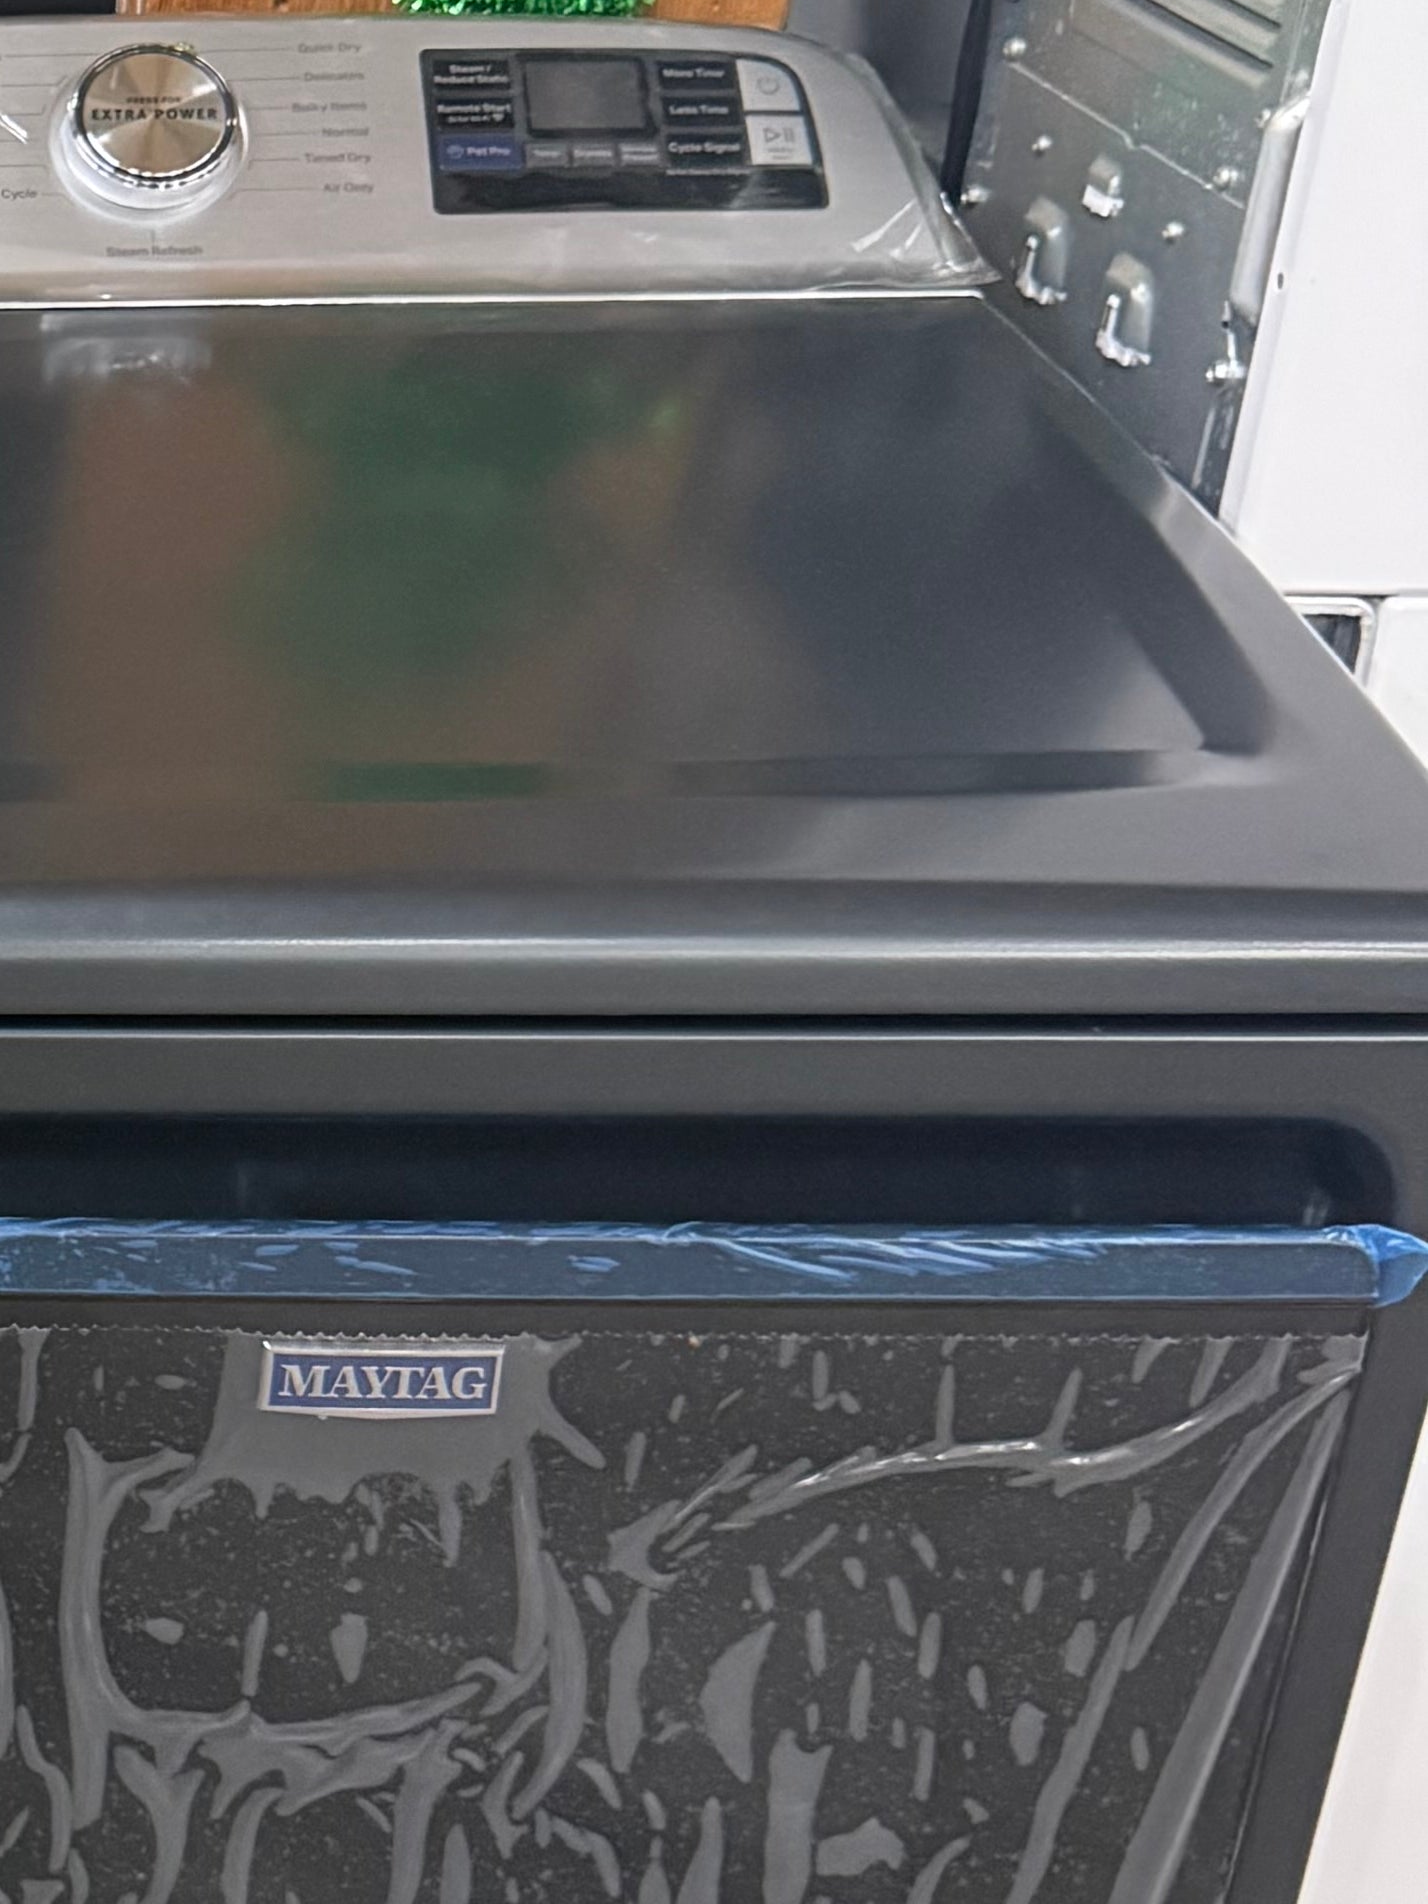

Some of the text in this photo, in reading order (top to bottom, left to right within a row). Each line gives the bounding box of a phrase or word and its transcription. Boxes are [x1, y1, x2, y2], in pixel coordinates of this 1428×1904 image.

[92, 108, 218, 120] EXTRA POWER
[1, 188, 37, 200] Cycle
[278, 1363, 487, 1399] MAYTAG
